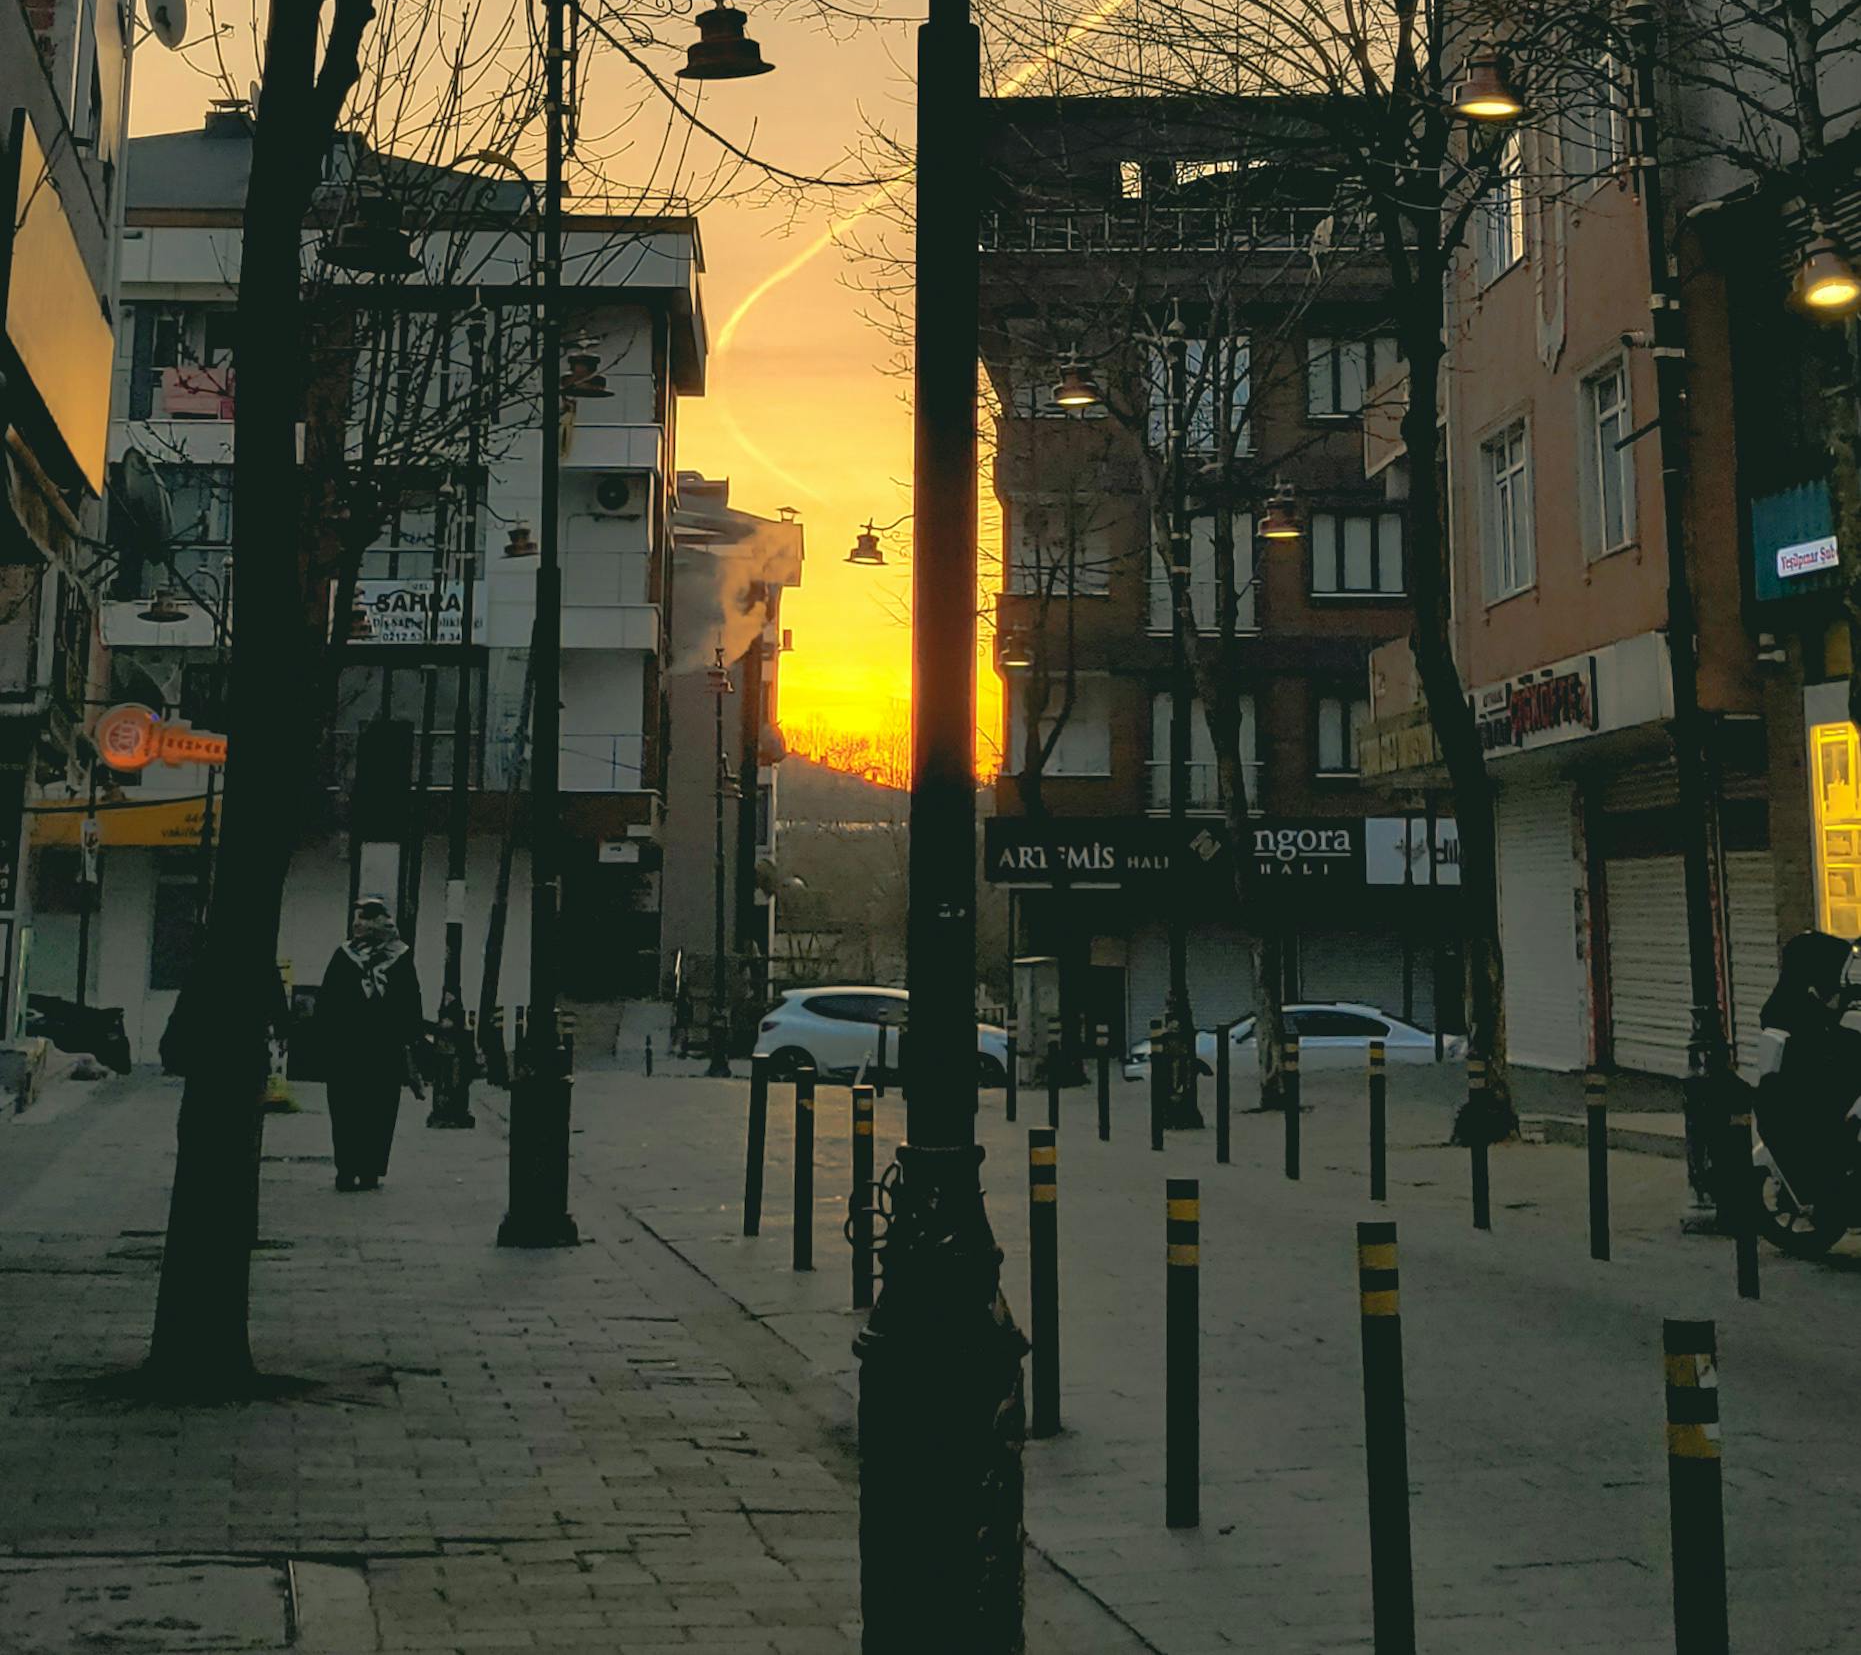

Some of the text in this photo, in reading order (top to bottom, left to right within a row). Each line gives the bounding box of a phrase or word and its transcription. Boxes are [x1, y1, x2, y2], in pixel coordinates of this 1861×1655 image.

[375, 592, 461, 612] SAHRA
[1252, 828, 1352, 861] ngora
[1127, 855, 1170, 870] HALI
[1259, 862, 1329, 875] HALI
